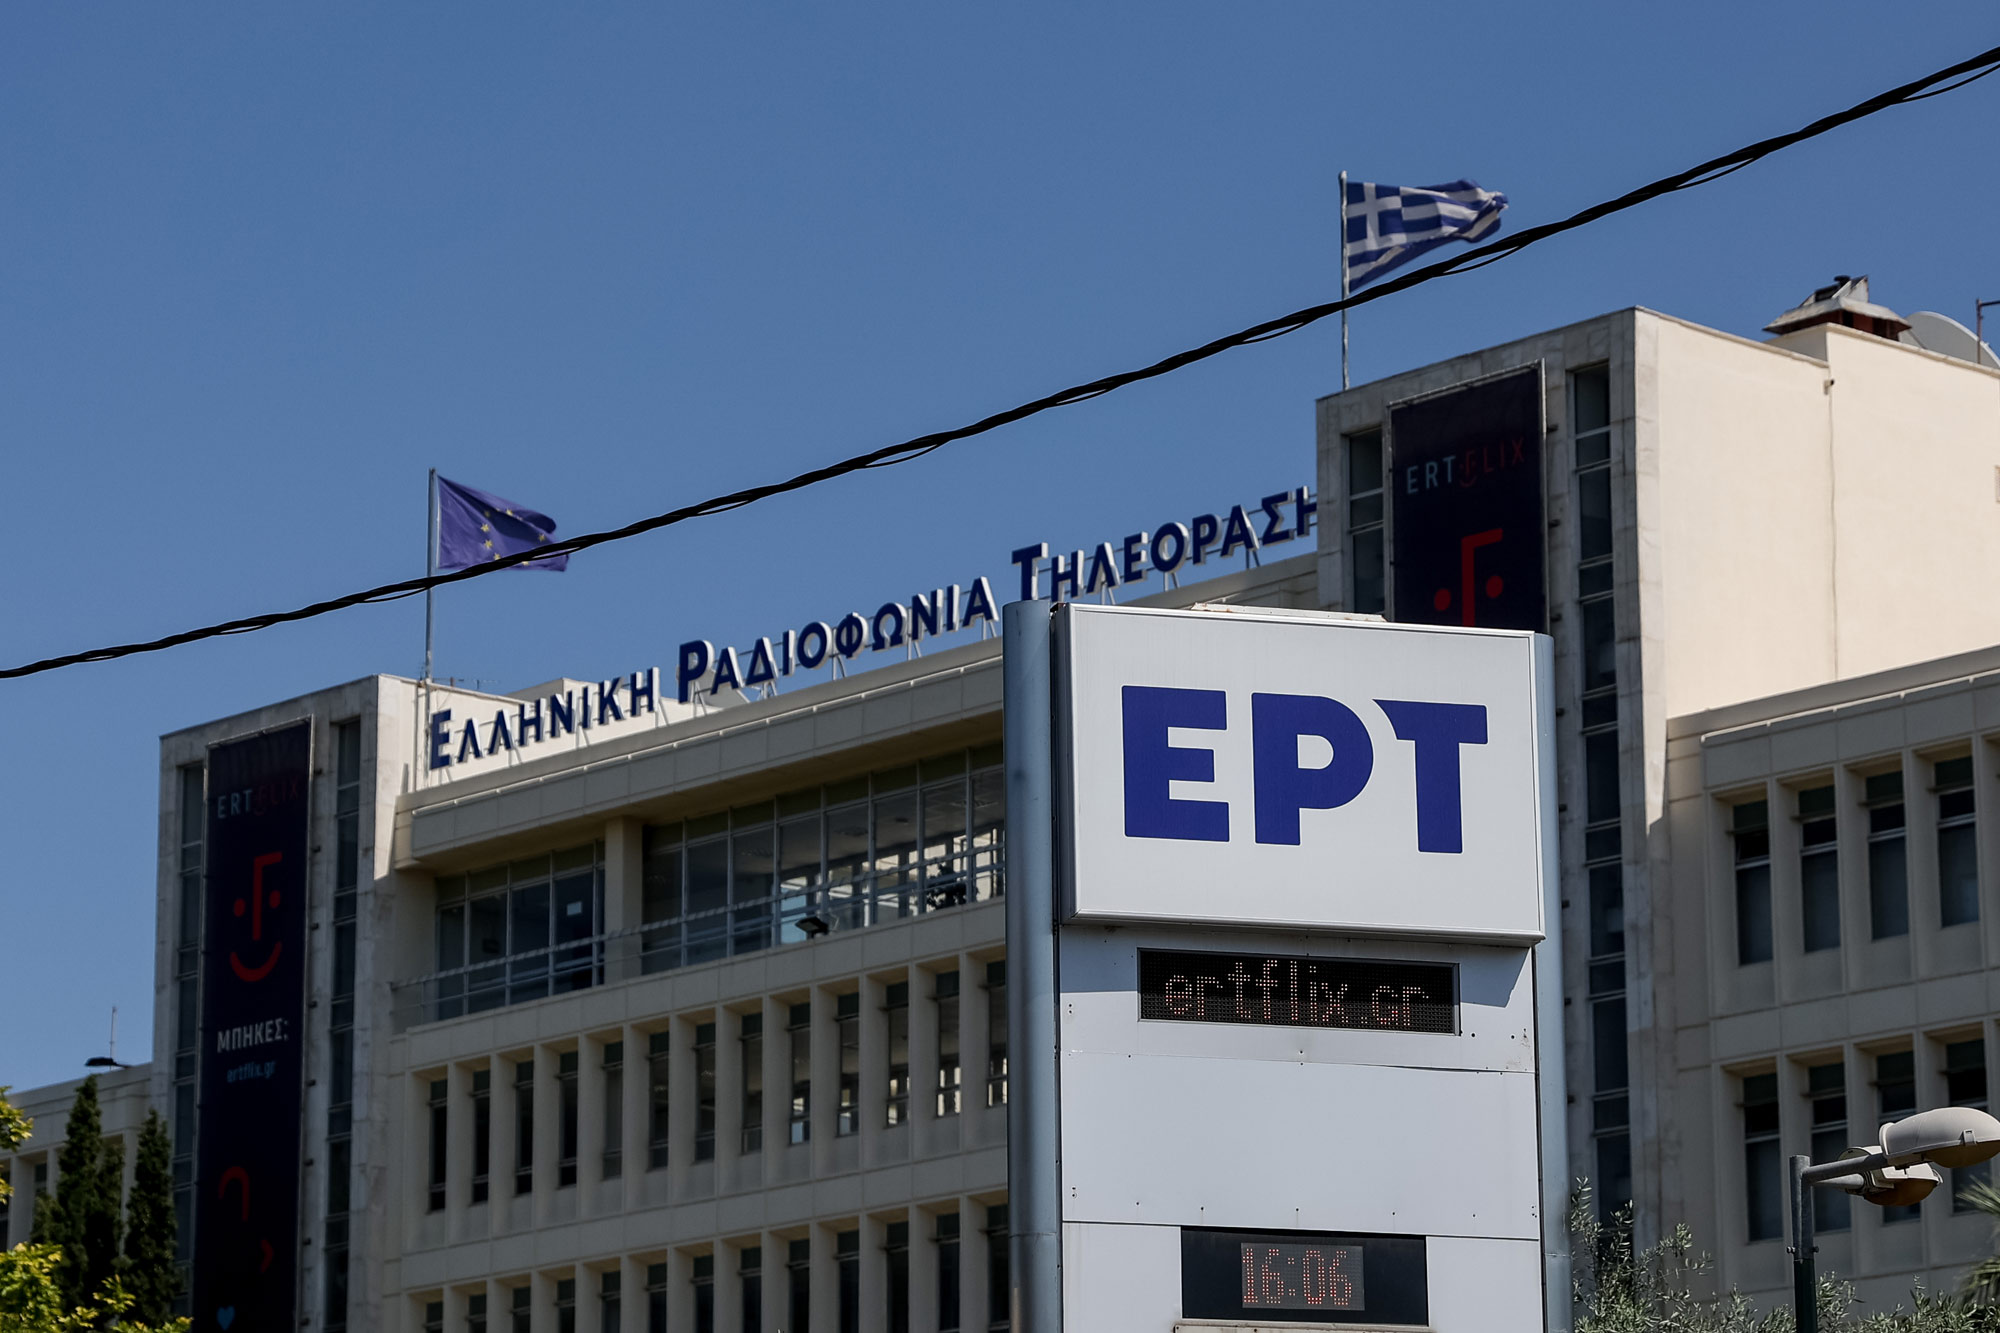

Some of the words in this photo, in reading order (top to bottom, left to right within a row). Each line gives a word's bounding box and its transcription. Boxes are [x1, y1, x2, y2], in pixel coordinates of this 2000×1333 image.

[430, 667, 659, 770] ΕΛΛΗΝΙΚΗ
[678, 576, 999, 703] ΡΑΔΙΟΦΩΝΙΑ
[1121, 685, 1488, 854] ΕΡΤ
[1242, 1248, 1351, 1306] 16:06
